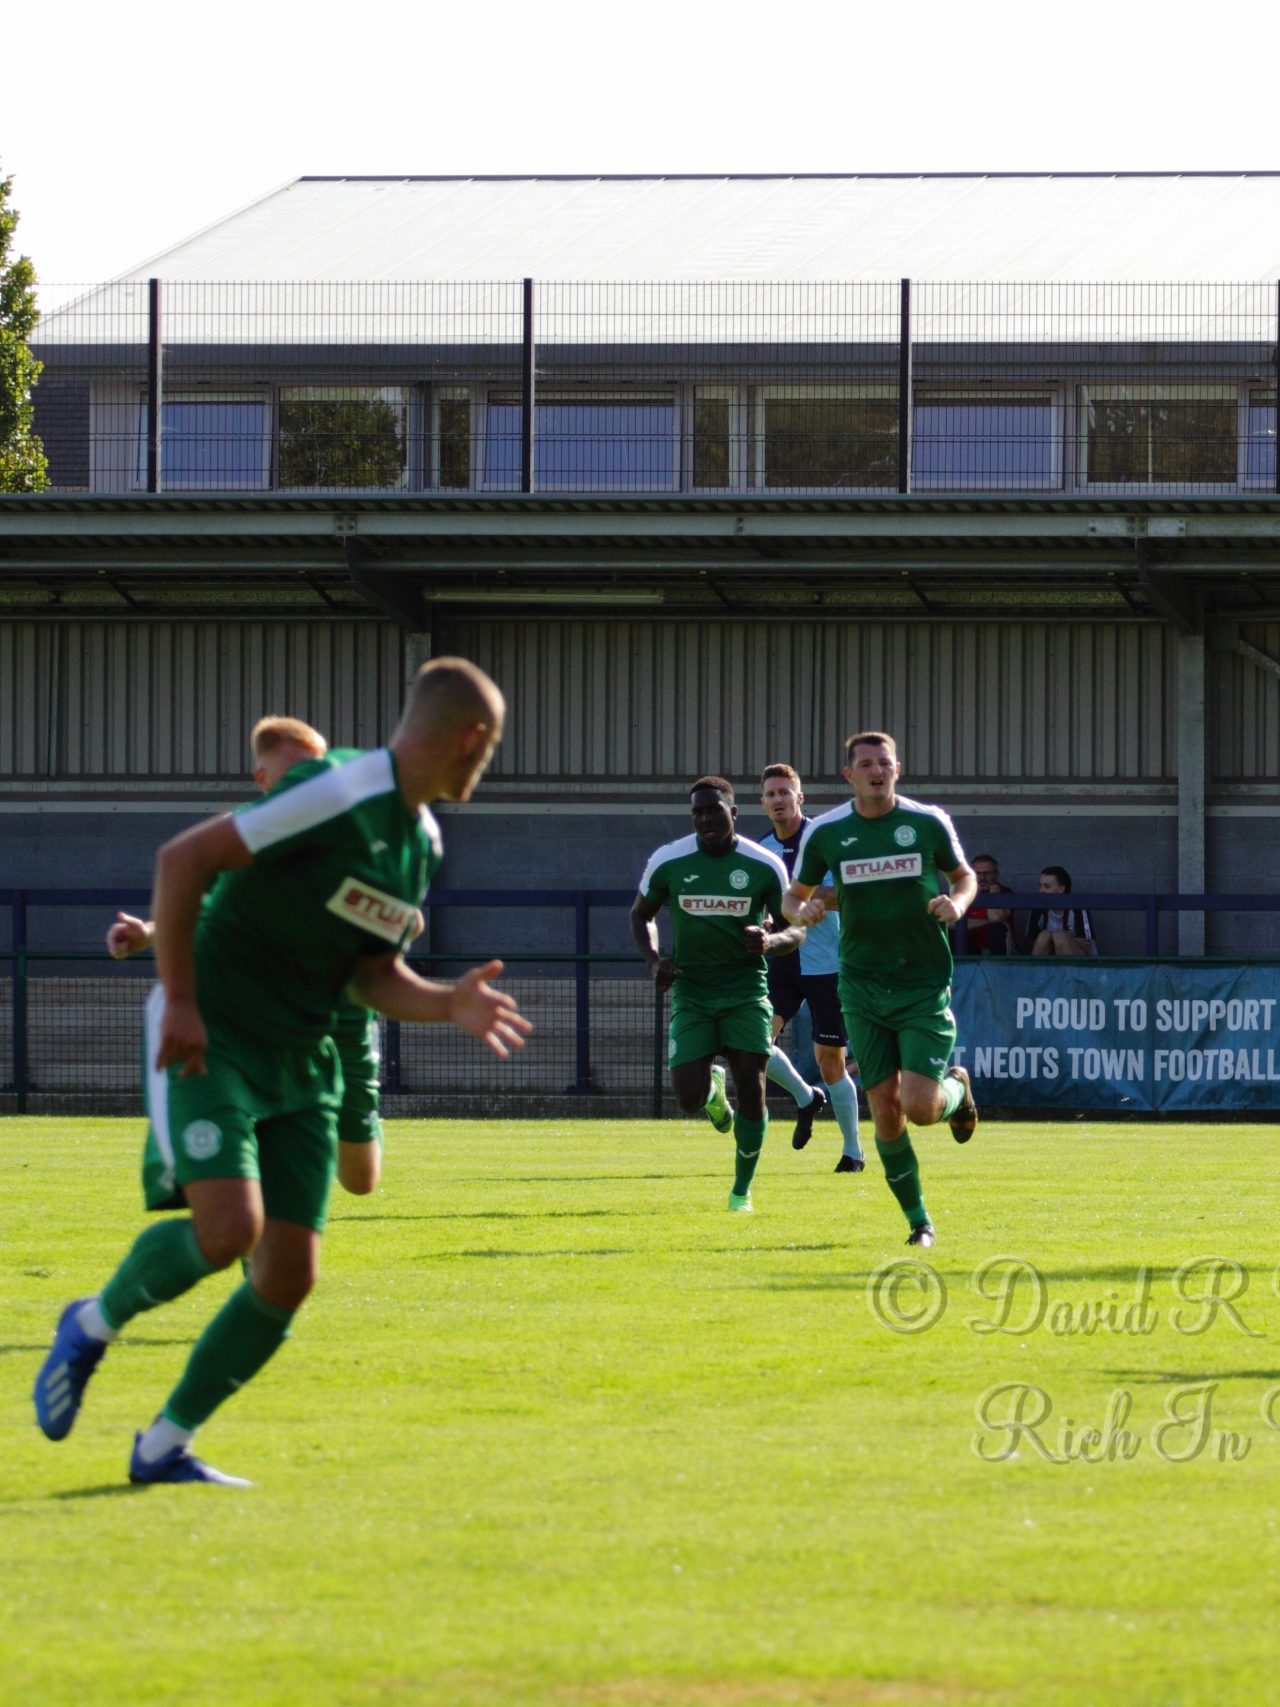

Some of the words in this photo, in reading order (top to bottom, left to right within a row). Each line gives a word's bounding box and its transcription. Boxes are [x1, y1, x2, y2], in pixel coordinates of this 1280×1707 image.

[846, 857, 917, 875] STUART
[682, 898, 748, 910] STUART
[1016, 997, 1106, 1031] PROUD
[1114, 998, 1147, 1031] TO
[1155, 999, 1277, 1032] SUPPORT
[974, 1046, 1060, 1080] NEOTS
[1067, 1047, 1145, 1081] TOWN
[1154, 1048, 1280, 1082] FOOTBALL
